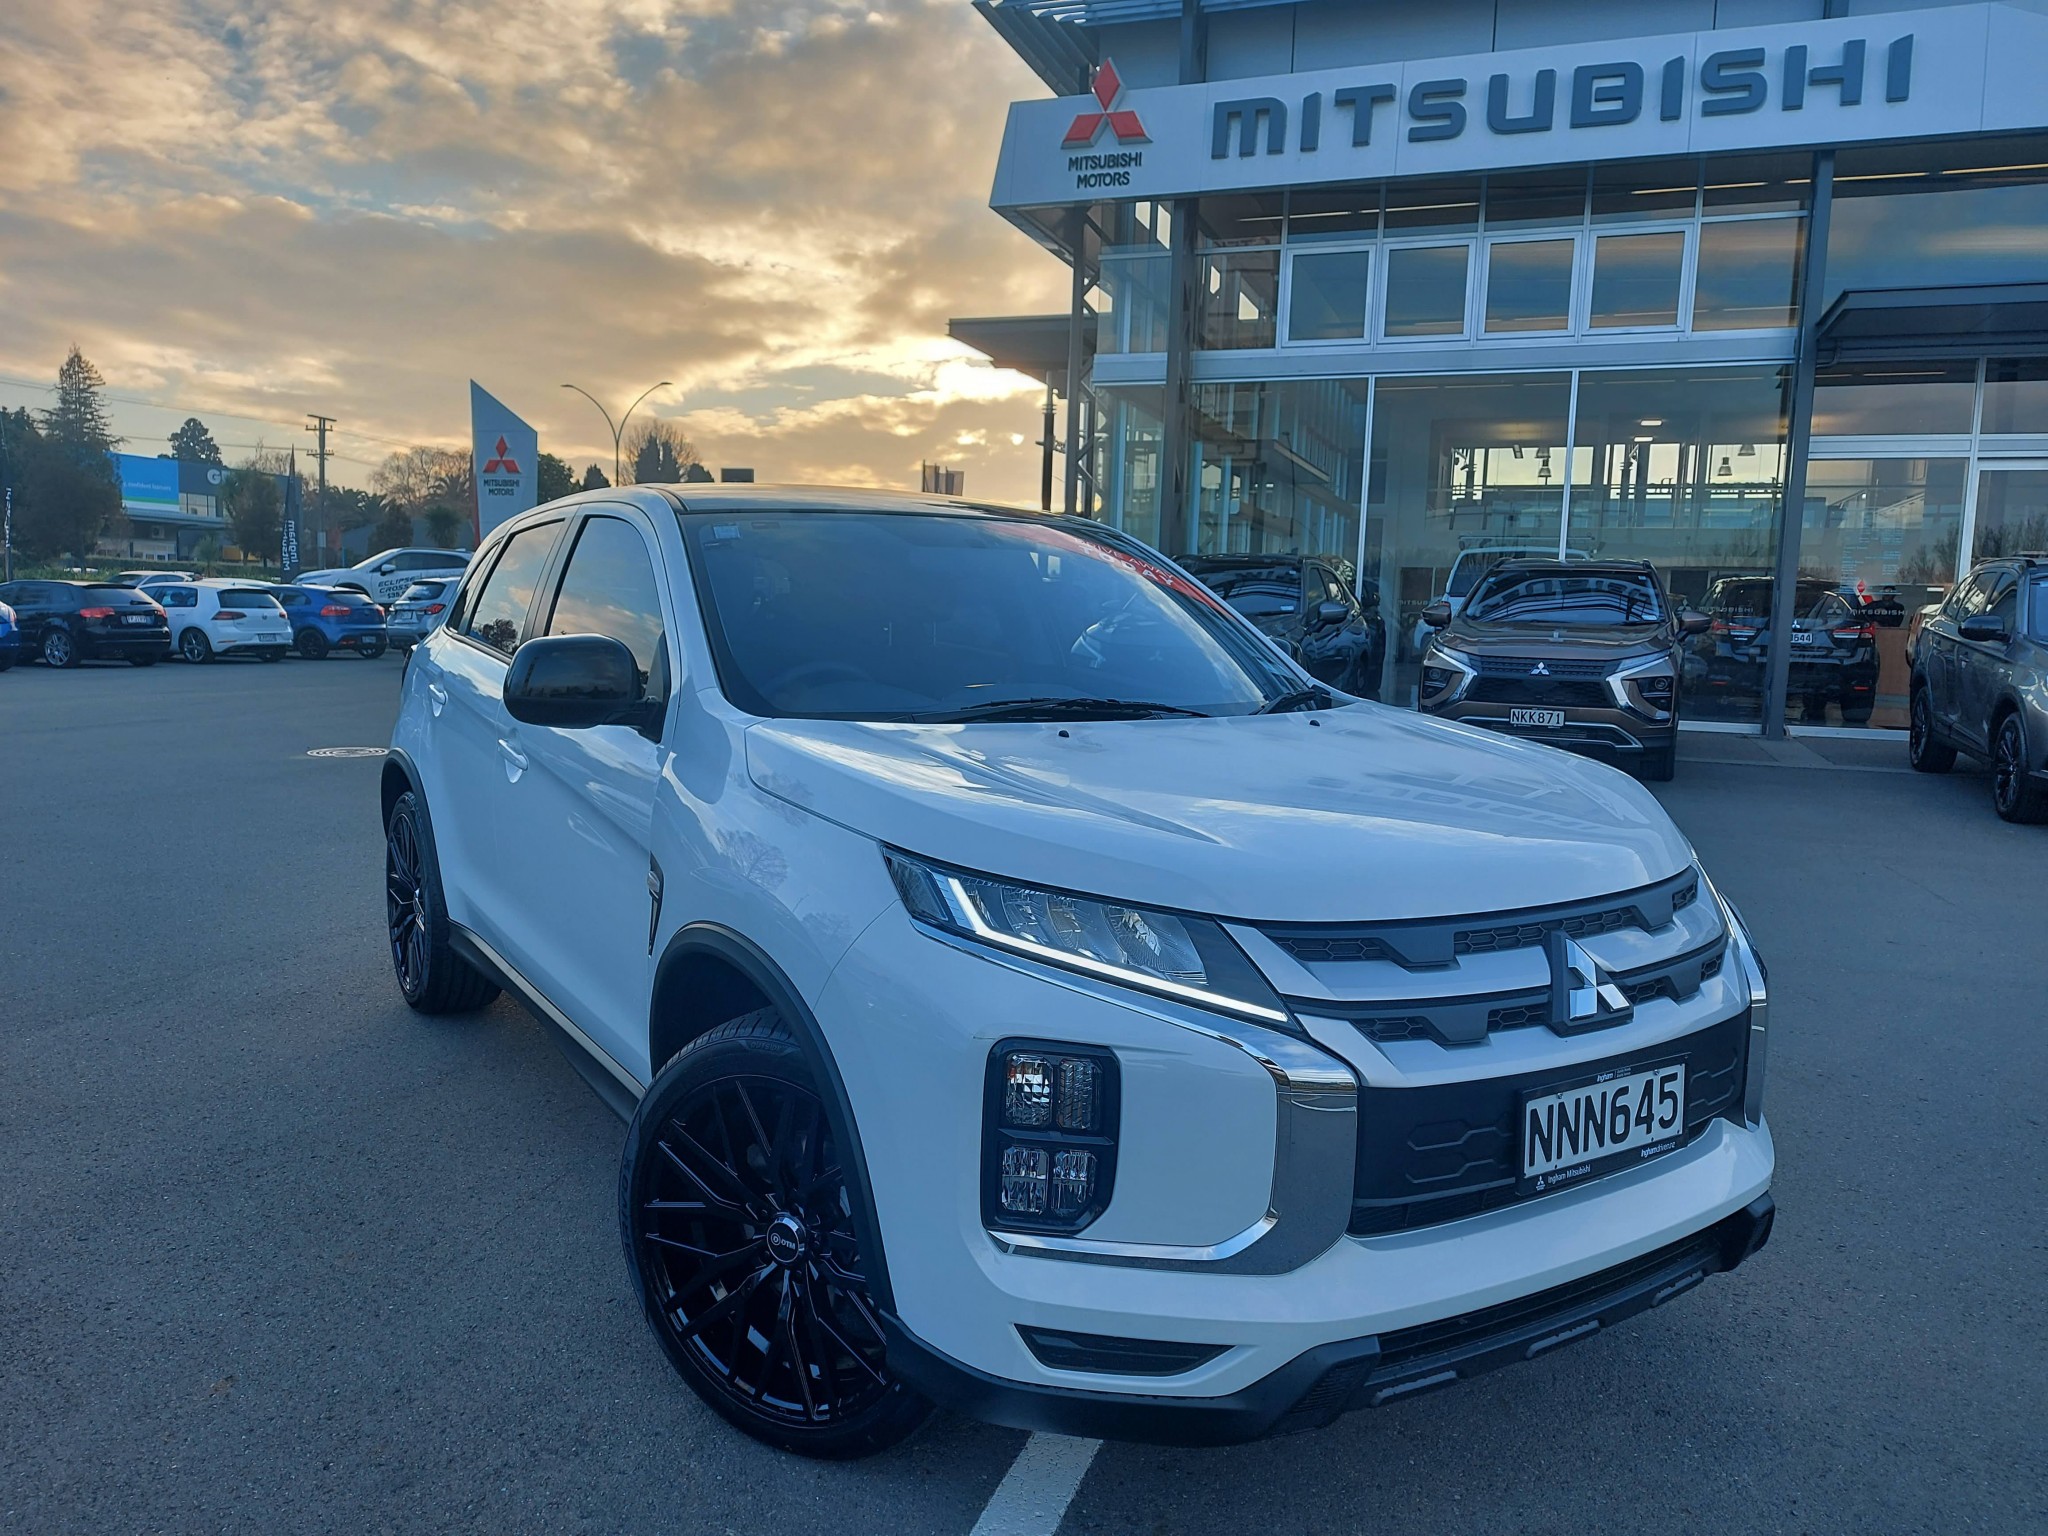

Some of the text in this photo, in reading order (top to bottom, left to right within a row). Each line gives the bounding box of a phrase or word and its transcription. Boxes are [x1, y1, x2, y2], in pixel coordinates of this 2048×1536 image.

[1211, 34, 1914, 159] MITSUBISHI
[1068, 152, 1142, 172] MITSUBISHI
[1077, 171, 1130, 189] MOTORS
[483, 479, 519, 488] MITSUBISHI
[488, 488, 514, 496] MOTORS
[1511, 710, 1561, 725] NKK871
[1528, 1071, 1679, 1168] NNN645
[1547, 1173, 1567, 1185] Ingham
